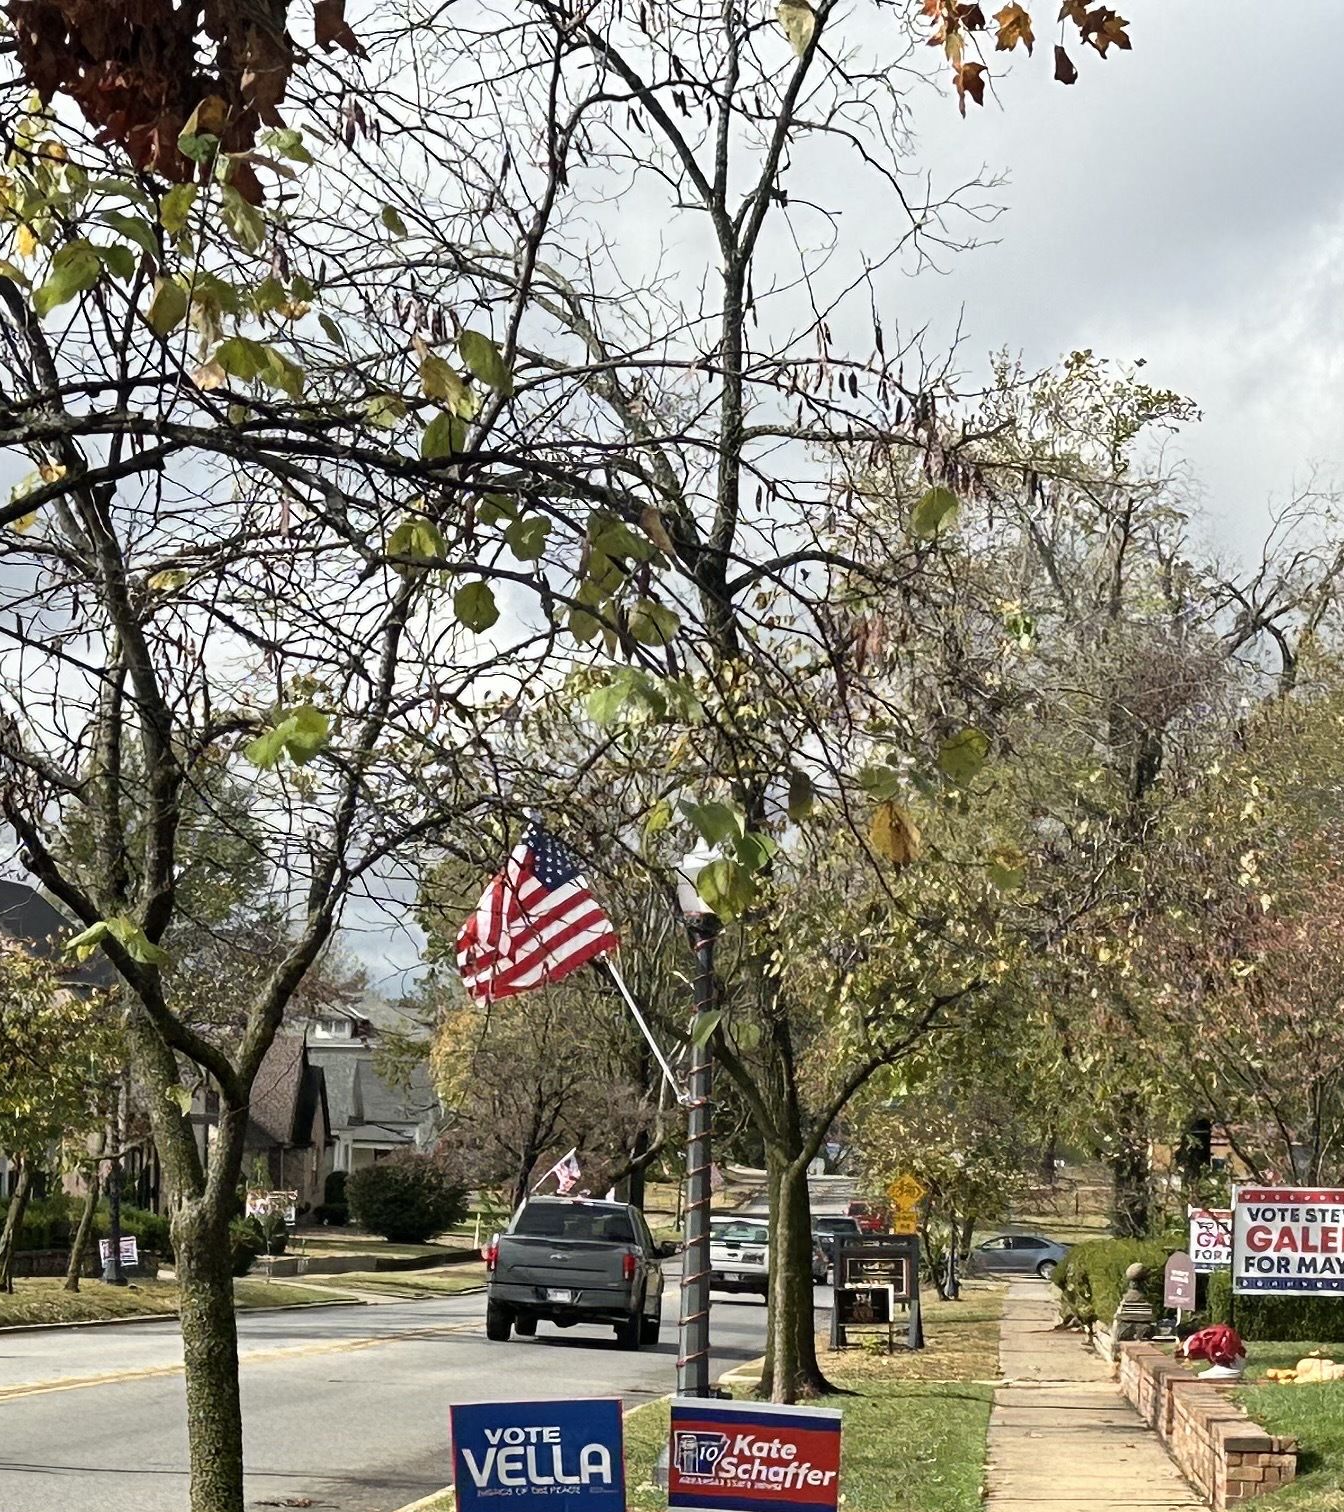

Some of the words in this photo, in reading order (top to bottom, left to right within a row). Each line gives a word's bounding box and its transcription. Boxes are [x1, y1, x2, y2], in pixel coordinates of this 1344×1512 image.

[1247, 1207, 1300, 1223] VOTE
[1244, 1256, 1291, 1274] FOR
[484, 1426, 561, 1445] VOTE
[700, 1446, 718, 1461] 10
[733, 1434, 797, 1460] Kate
[461, 1443, 613, 1488] VELLA
[718, 1457, 837, 1489] Schaffer
